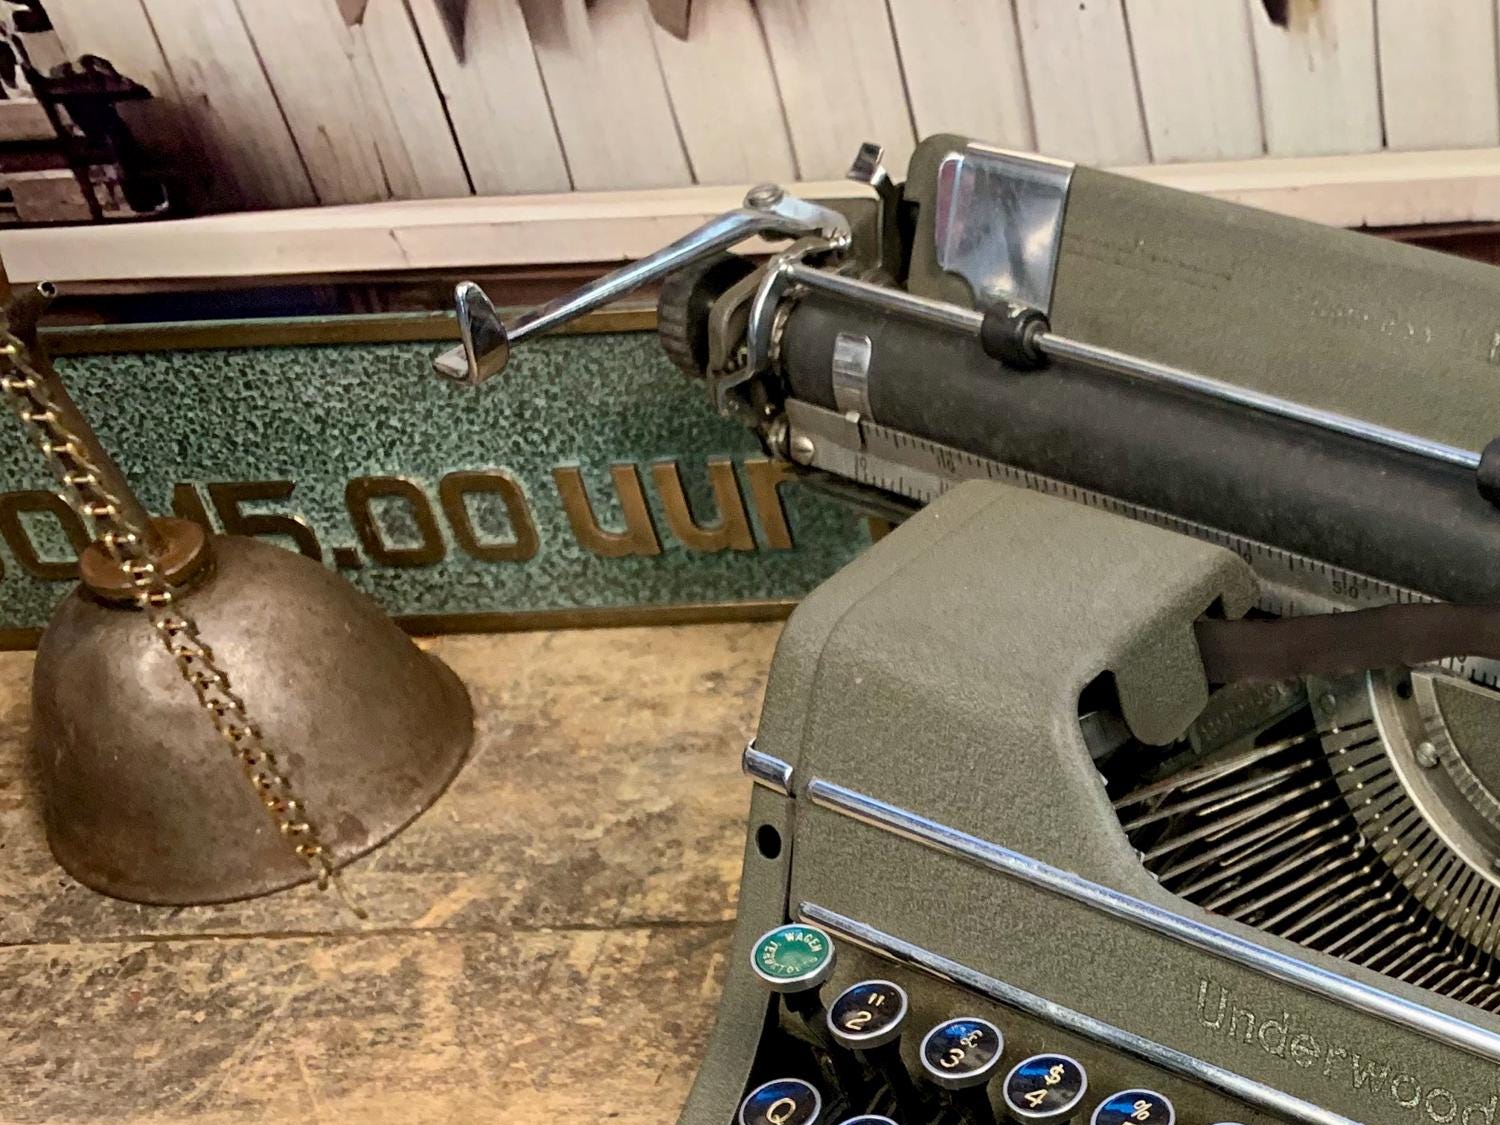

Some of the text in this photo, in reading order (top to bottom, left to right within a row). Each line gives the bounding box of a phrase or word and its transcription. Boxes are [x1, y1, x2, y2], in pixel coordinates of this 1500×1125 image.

[553, 456, 797, 557] uur
[847, 1010, 872, 1030] 2
[941, 1048, 965, 1068] 3
[1044, 1063, 1065, 1086] $
[1023, 1087, 1045, 1108] 4
[1131, 1100, 1153, 1121] %
